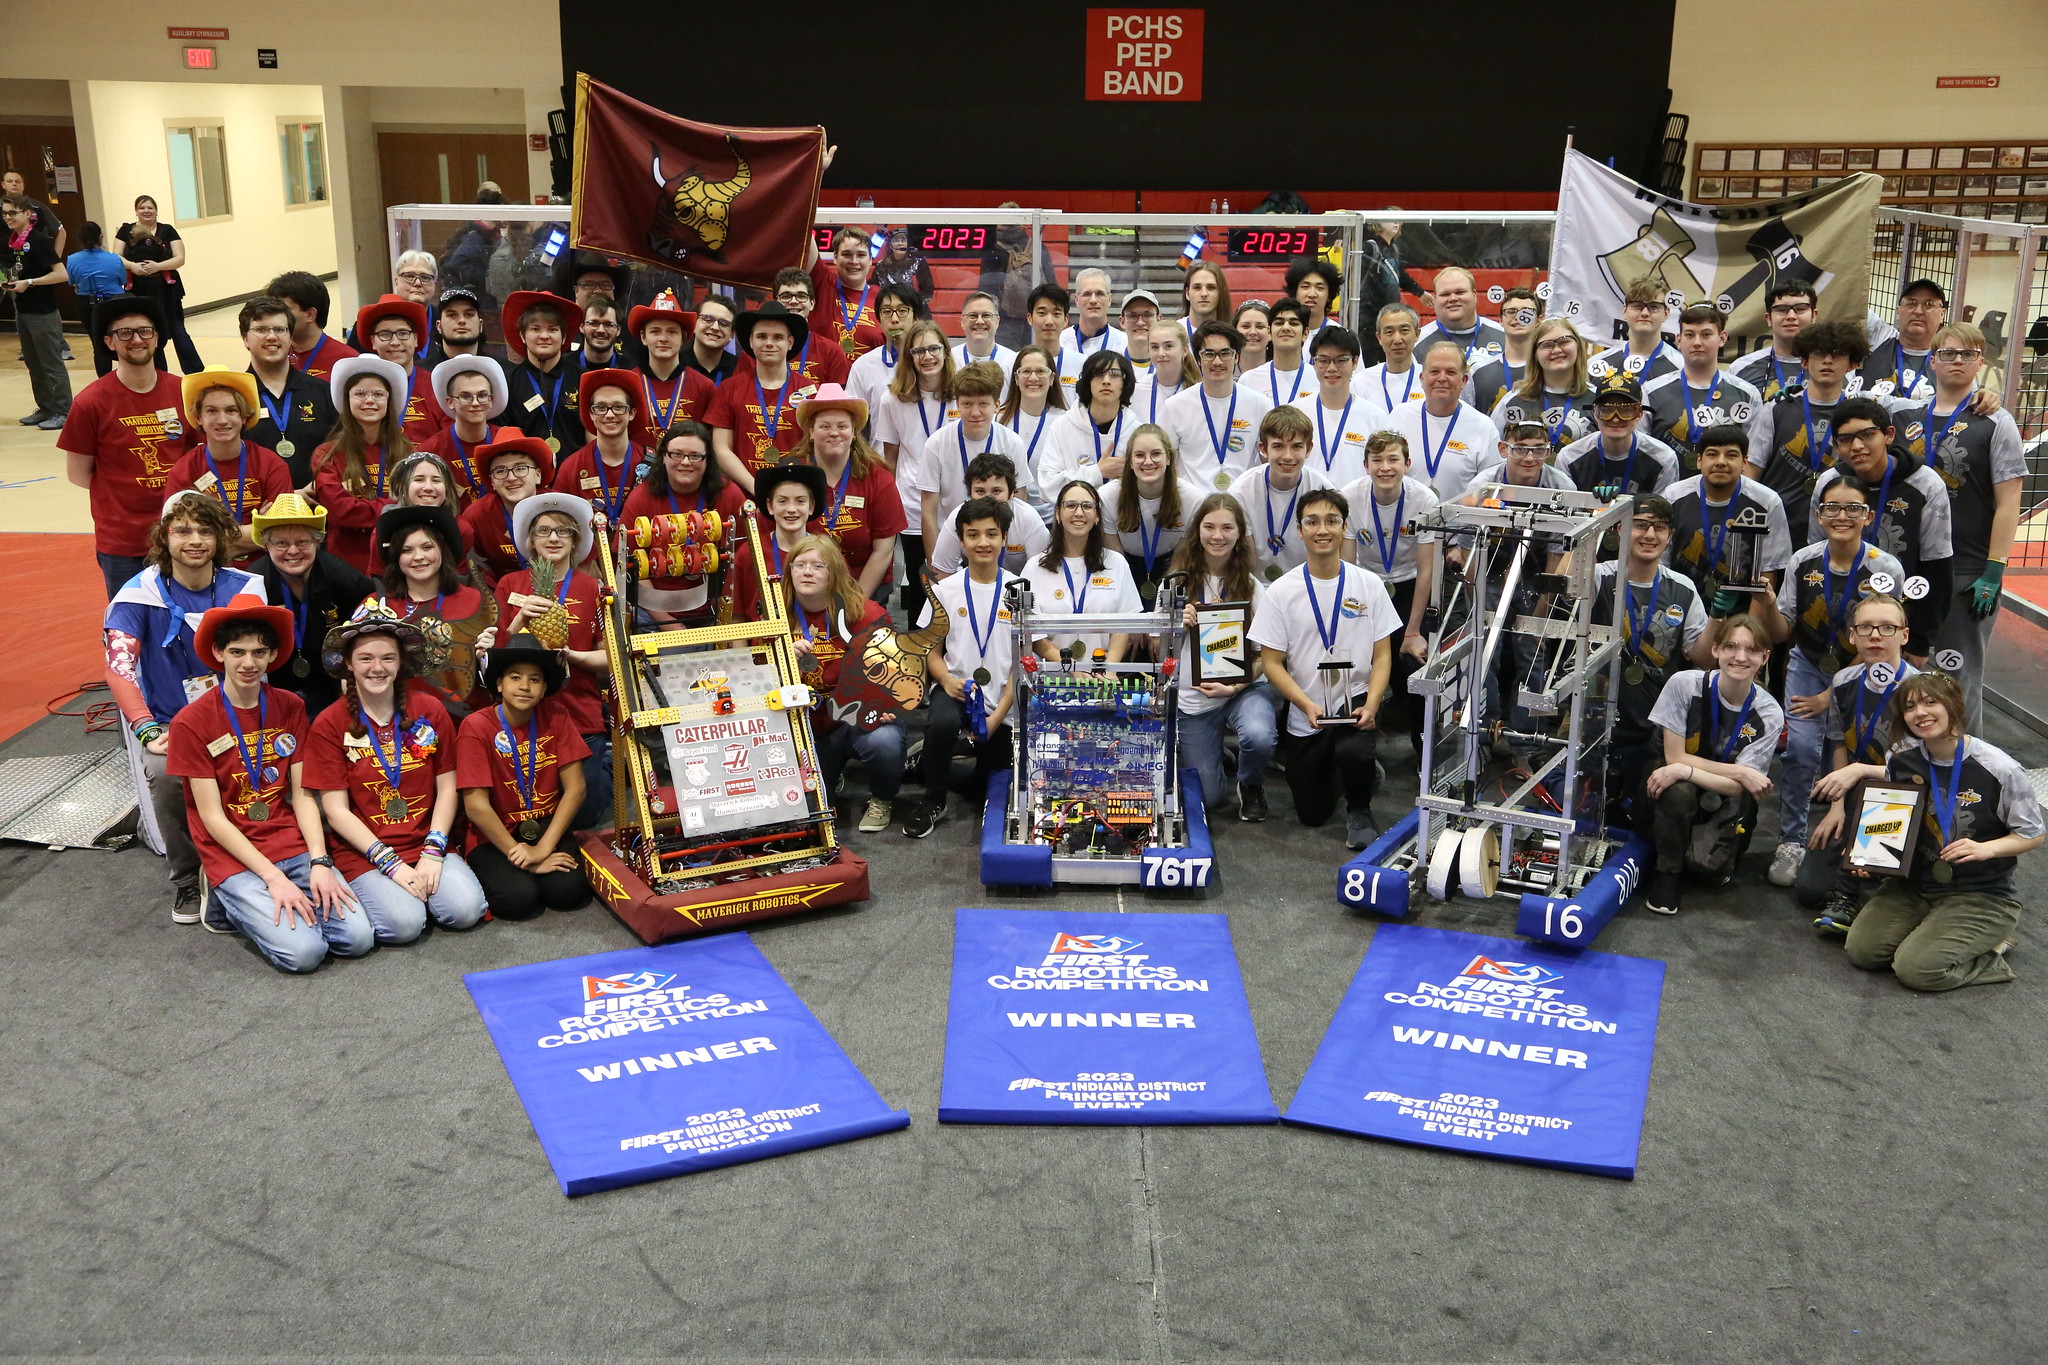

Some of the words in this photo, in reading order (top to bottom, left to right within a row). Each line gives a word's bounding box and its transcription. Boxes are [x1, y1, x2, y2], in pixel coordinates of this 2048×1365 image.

[1107, 15, 1183, 39] PCHS
[187, 48, 212, 67] EXIT
[1117, 43, 1172, 67] PEP
[1104, 71, 1183, 95] BAND
[923, 229, 986, 249] 2023
[1244, 233, 1307, 253] 2023
[1773, 238, 1800, 270] 16
[1567, 301, 1580, 315] 16
[1507, 409, 1522, 420] 81
[1697, 408, 1713, 424] 81
[1734, 404, 1750, 420] 16
[1873, 575, 1892, 591] 81
[1907, 578, 1927, 596] 16
[1206, 638, 1229, 653] CHARGED
[1230, 636, 1238, 645] UP
[1941, 651, 1960, 667] 16
[1873, 664, 1893, 683] 81
[674, 718, 768, 744] CATERPILLAR
[683, 747, 701, 757] Bayer
[702, 745, 718, 754] Fund
[771, 766, 796, 777] Rea
[699, 787, 720, 796] FIRST
[711, 798, 738, 808] Maverick
[740, 795, 765, 804] Robotics
[715, 808, 738, 816] Alumni
[739, 804, 764, 812] Network
[1865, 822, 1893, 834] CHARGED
[1893, 821, 1902, 831] UP
[1143, 856, 1212, 887] 7617
[1343, 868, 1381, 905] 81
[696, 902, 751, 921] MAVERICK
[752, 894, 800, 912] ROBOTICS
[1544, 902, 1584, 939] 16
[1015, 965, 1178, 979] ROBOTICS
[987, 975, 1209, 992] COMPETITION
[1416, 981, 1589, 1017] ROBOTICS
[558, 994, 731, 1032] ROBOTICS
[1006, 1012, 1197, 1029] WINNER
[1383, 992, 1618, 1035] COMPETITION
[537, 999, 770, 1049] COMPETITION
[1392, 1025, 1589, 1070] WINNER
[576, 1036, 778, 1083] WINNER
[1071, 1082, 1134, 1091] INDIANA
[1138, 1081, 1207, 1092] DISTRICT
[1076, 1072, 1135, 1082] 2023
[1045, 1090, 1171, 1102] PRINCETON
[1437, 1092, 1500, 1110] 2023
[684, 1118, 751, 1138] INDIANA
[752, 1103, 821, 1123] DISTRICT
[685, 1107, 747, 1126] 2023
[1397, 1106, 1530, 1136] PRINCETON
[1429, 1101, 1494, 1120] INDIANA
[1499, 1112, 1573, 1131] DISTRICT
[663, 1121, 793, 1154] PRINCETON
[1423, 1122, 1499, 1142] EVENT
